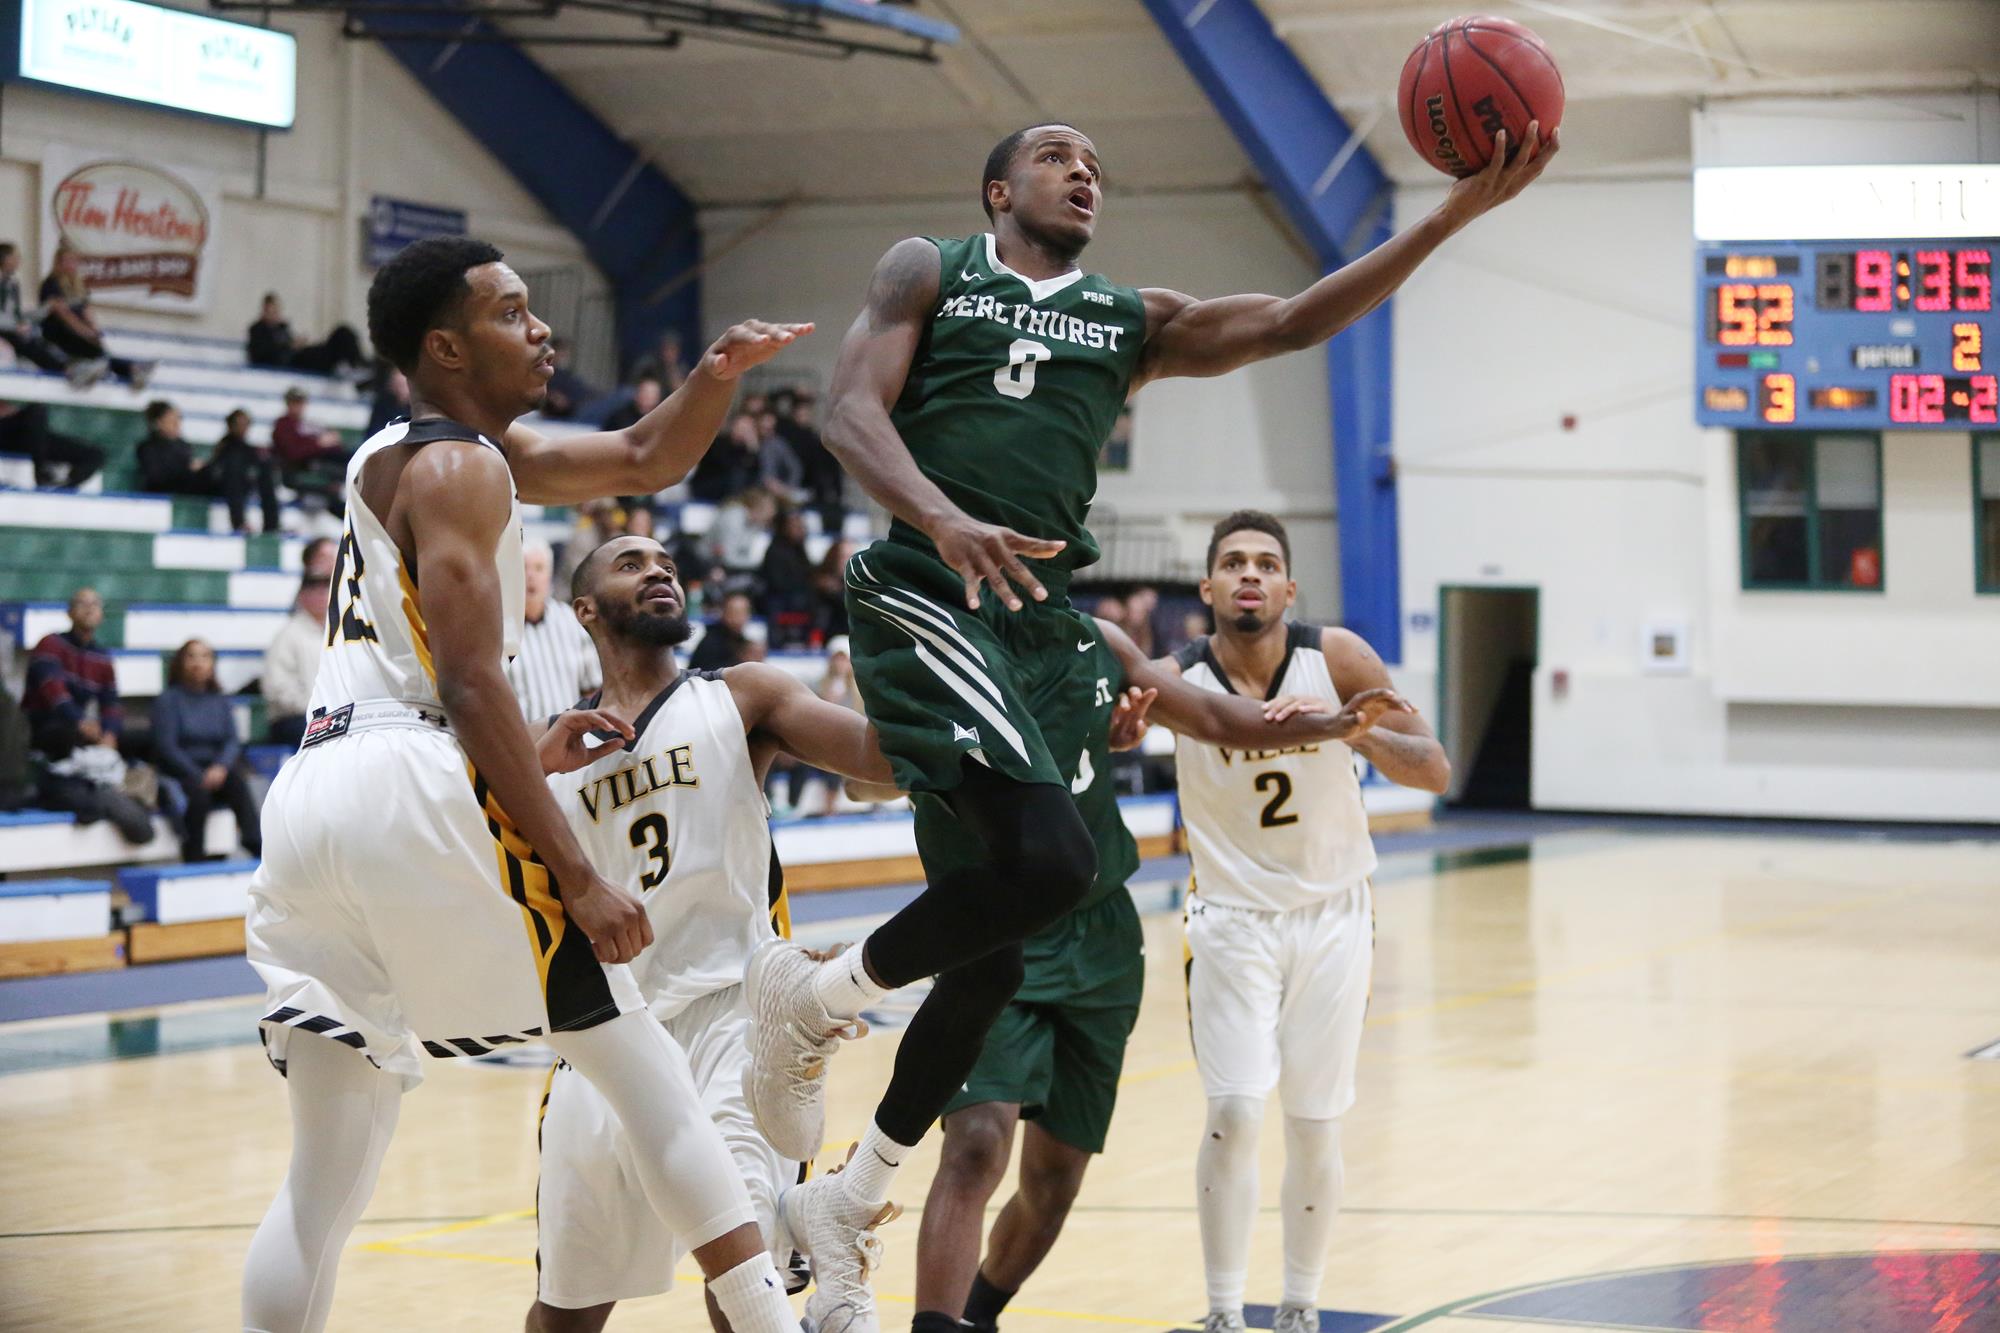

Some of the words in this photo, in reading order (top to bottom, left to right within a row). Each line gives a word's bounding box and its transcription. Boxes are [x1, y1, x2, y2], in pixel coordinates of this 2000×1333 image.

[59, 179, 108, 232] Tim
[1082, 290, 1114, 307] PSAC
[1855, 249, 1992, 312] 9:35
[937, 295, 1124, 352] MERCYHURST
[1718, 283, 1794, 346] 52
[993, 338, 1052, 400] 0
[1953, 322, 1982, 372] 2
[1763, 373, 1796, 423] 3
[326, 510, 380, 649] 12
[577, 742, 700, 824] VILLE
[1254, 771, 1299, 829] 2
[629, 812, 670, 892] 3
